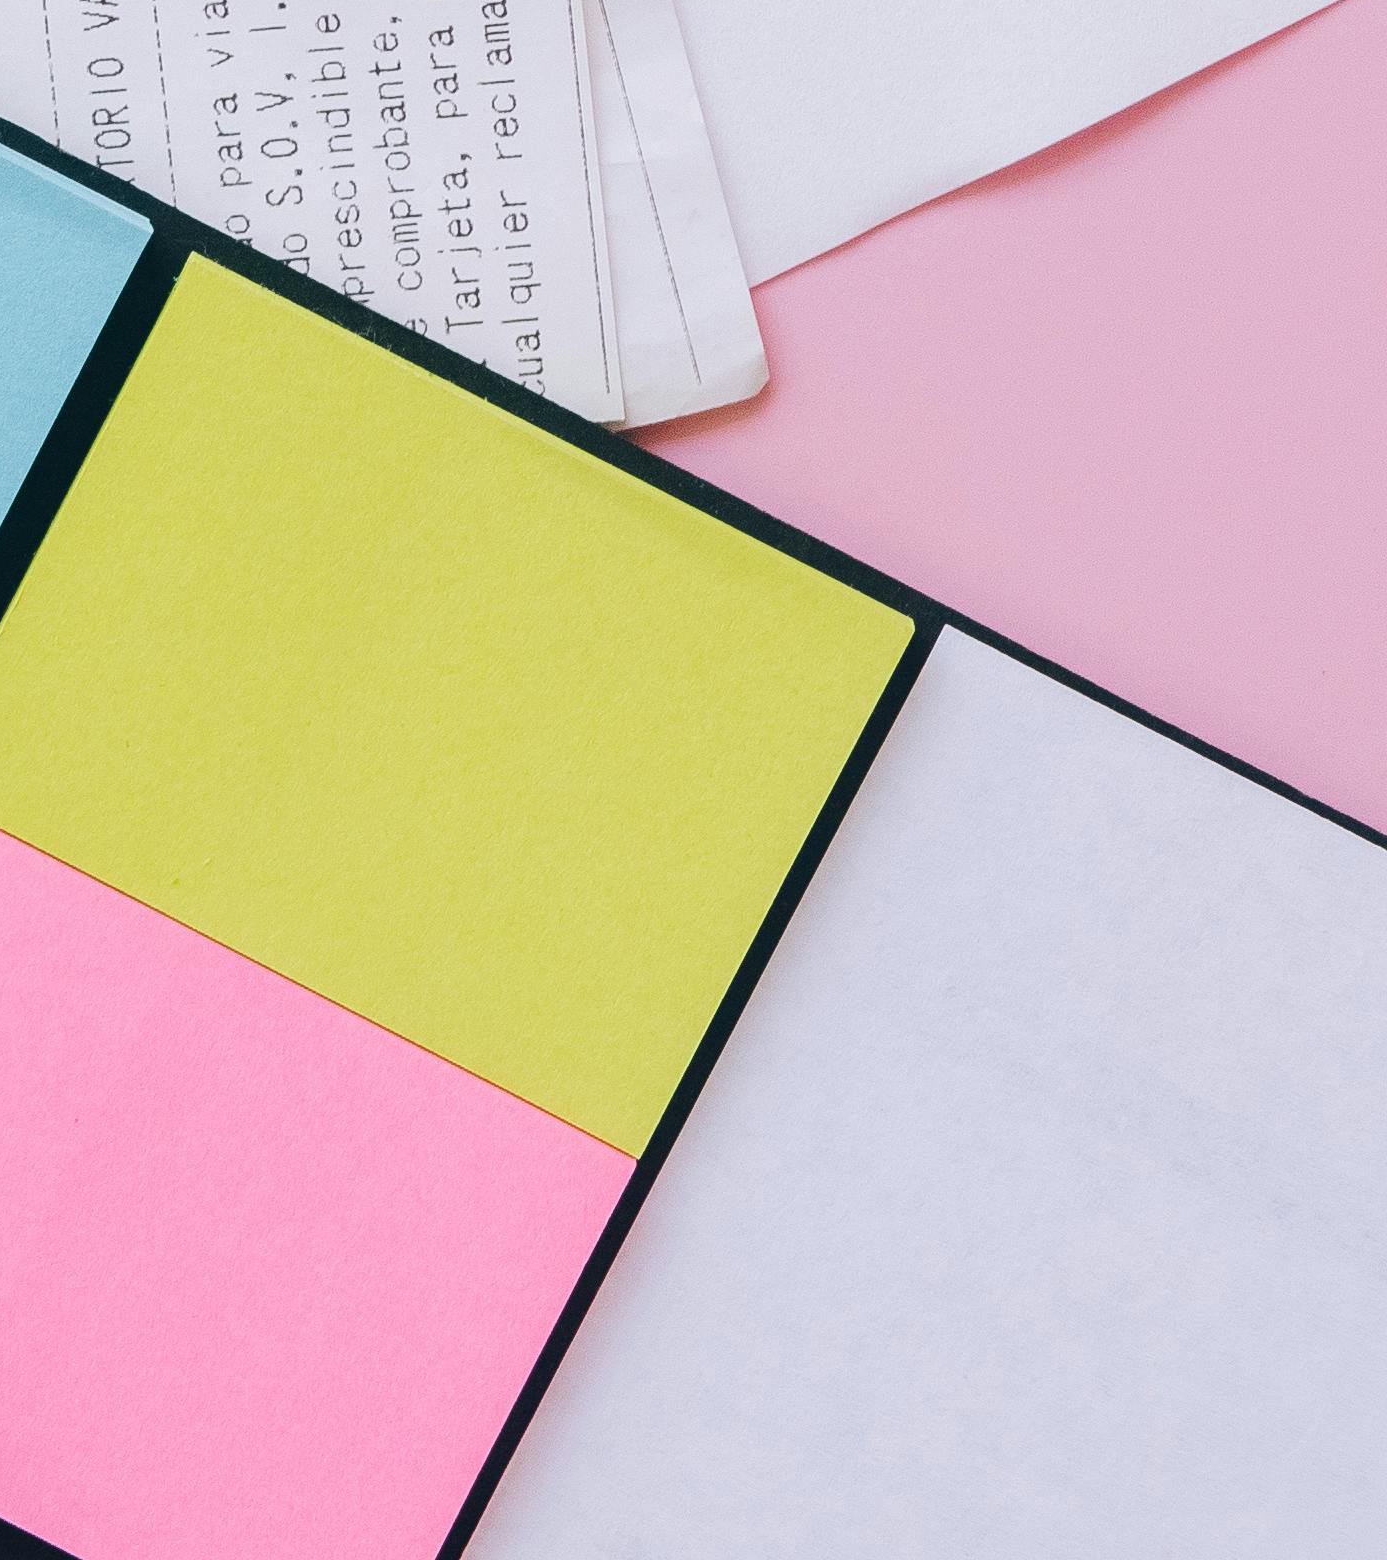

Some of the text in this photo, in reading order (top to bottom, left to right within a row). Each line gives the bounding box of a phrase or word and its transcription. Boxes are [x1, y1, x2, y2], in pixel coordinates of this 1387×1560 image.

[211, 91, 254, 189] para
[253, 71, 306, 209] S.O.V,
[367, 15, 425, 293] comprobante,
